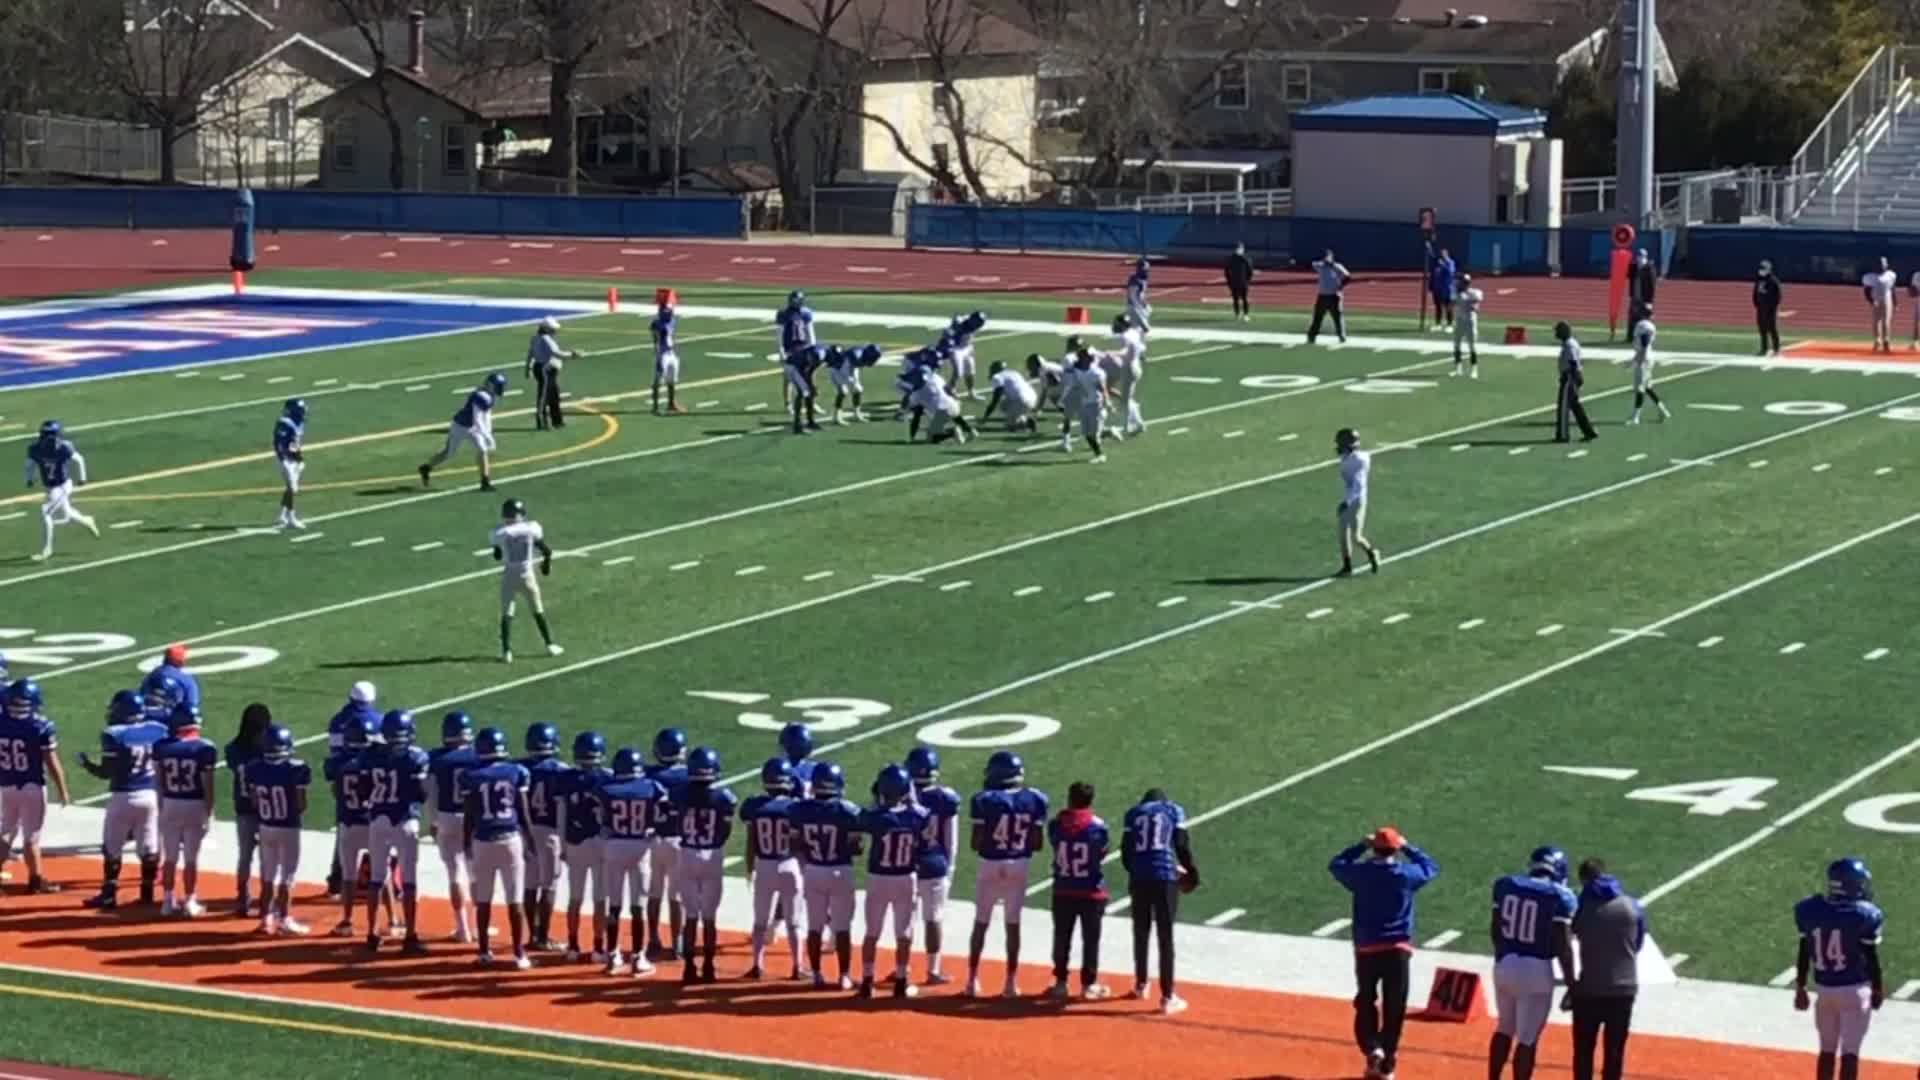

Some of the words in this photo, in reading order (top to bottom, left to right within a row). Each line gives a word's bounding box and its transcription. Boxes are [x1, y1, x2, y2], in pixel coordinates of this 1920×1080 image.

[0, 739, 29, 771] 56
[164, 758, 197, 792] 23
[344, 774, 359, 809] 5
[257, 785, 288, 820] 60
[480, 780, 515, 819] 13
[531, 781, 548, 818] 4
[612, 800, 647, 835] 28
[684, 808, 717, 846] 43
[756, 817, 790, 855] 86
[803, 824, 838, 861] 57
[993, 812, 1031, 851] 45
[880, 832, 913, 868] 10
[1056, 841, 1089, 878] 42
[1501, 894, 1539, 943] 90
[1812, 927, 1847, 971] 14
[1436, 969, 1472, 1013] 40
